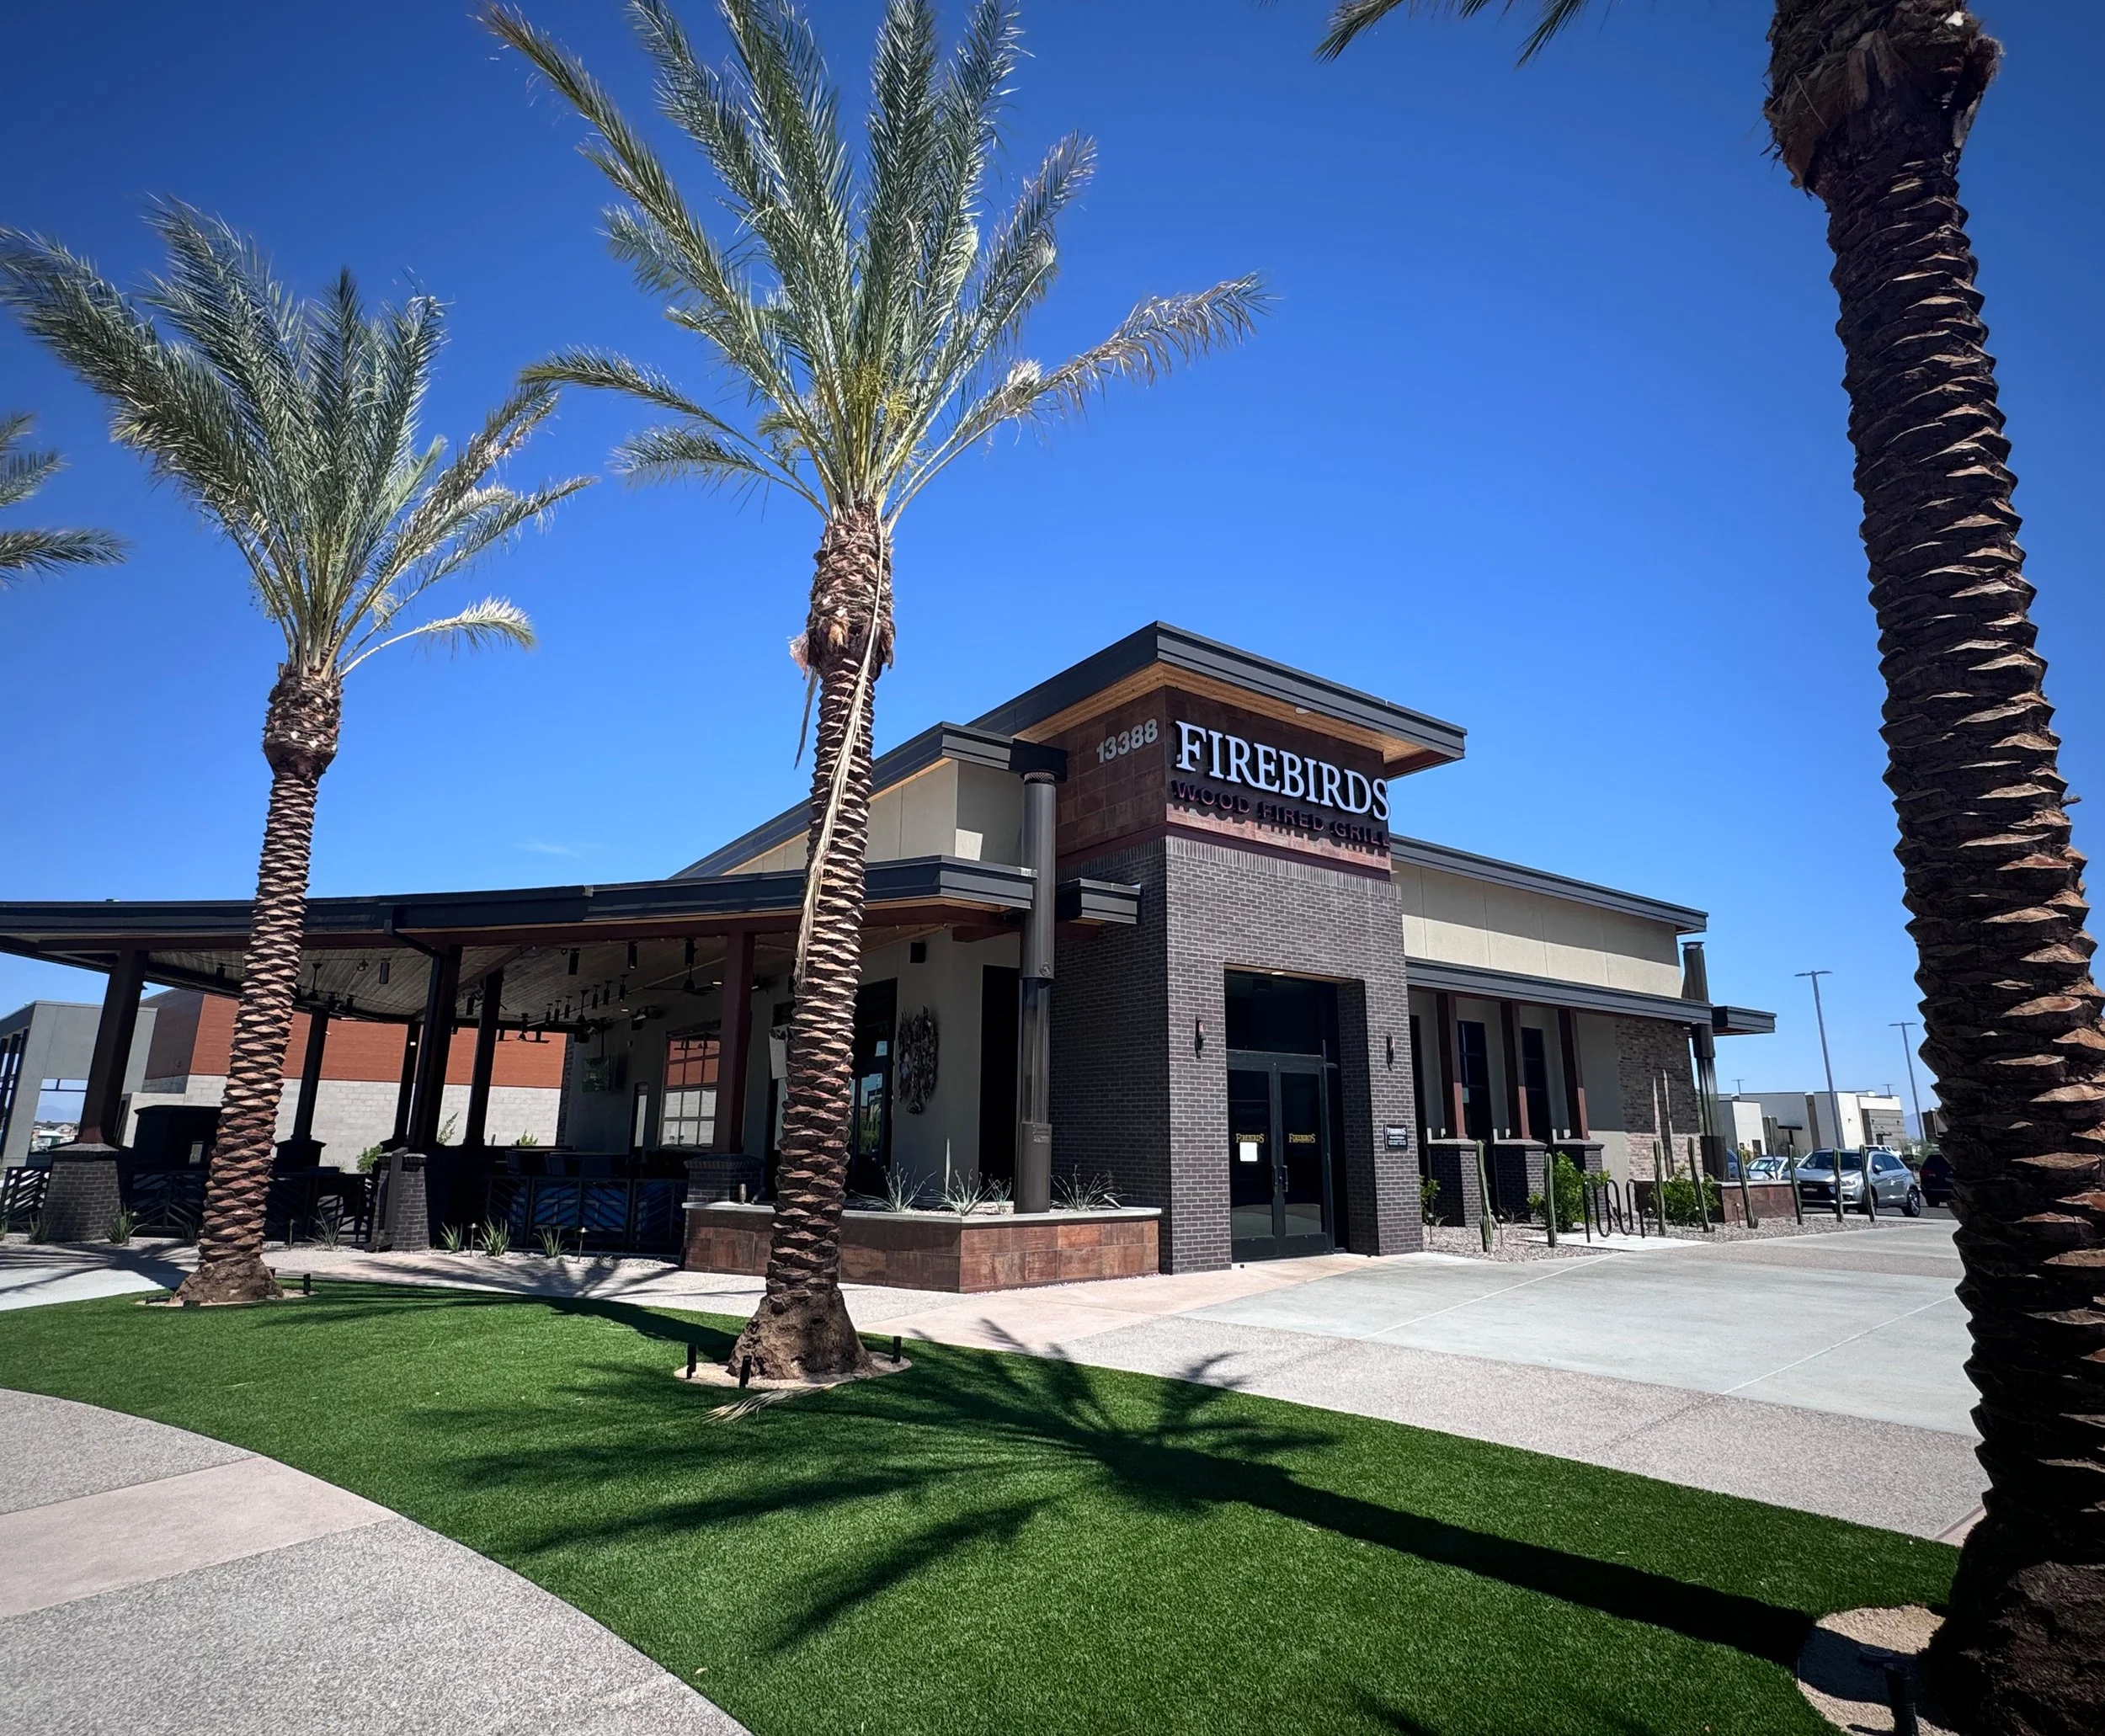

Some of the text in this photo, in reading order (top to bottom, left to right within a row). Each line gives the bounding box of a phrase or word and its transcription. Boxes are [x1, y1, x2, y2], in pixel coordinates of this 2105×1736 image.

[1096, 719, 1159, 763] 13388
[1175, 721, 1391, 821] FIREBIRDS
[1173, 780, 1391, 848] WOOD FIRED GRILL
